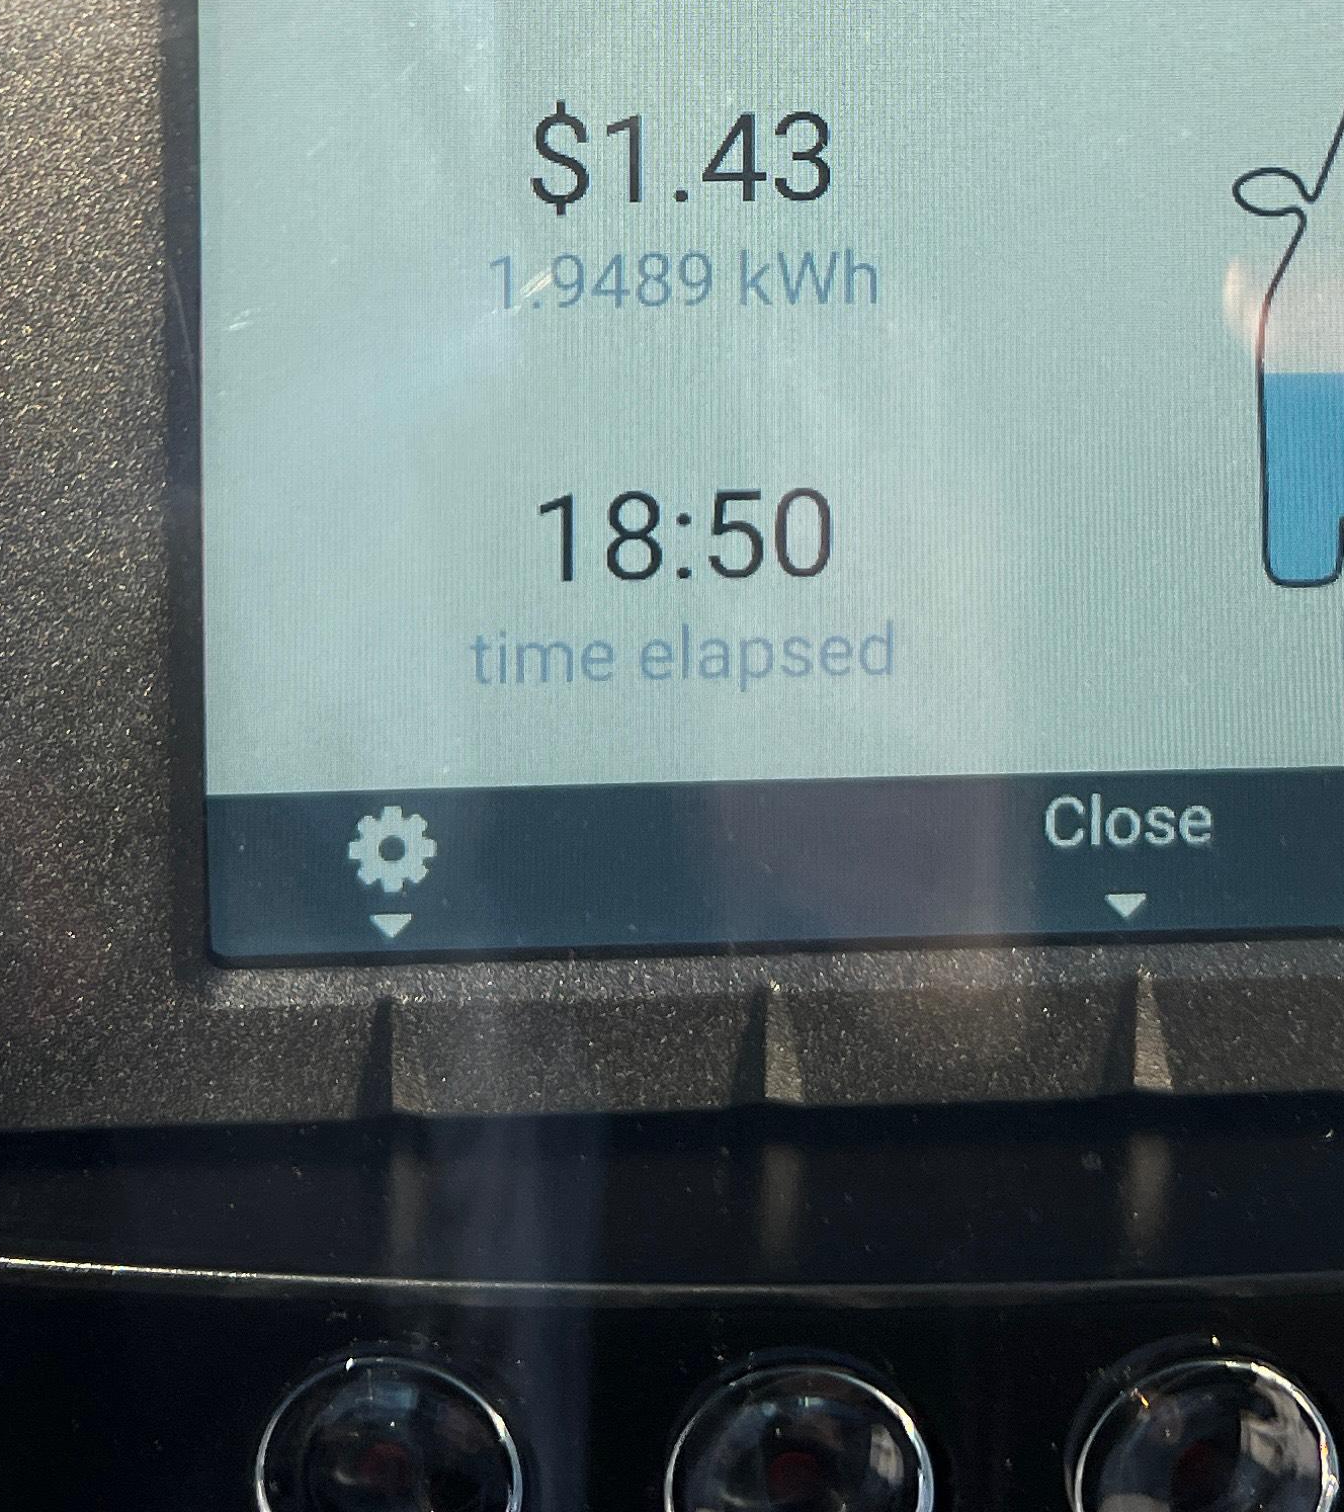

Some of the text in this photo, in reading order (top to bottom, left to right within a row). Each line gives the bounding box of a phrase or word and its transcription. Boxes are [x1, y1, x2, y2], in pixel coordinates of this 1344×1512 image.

[529, 99, 833, 216] $1.43
[488, 248, 880, 310] 1.9489 kWh
[537, 487, 833, 583] 18:50
[469, 619, 896, 694] time elapsed
[1043, 792, 1214, 849] Close
